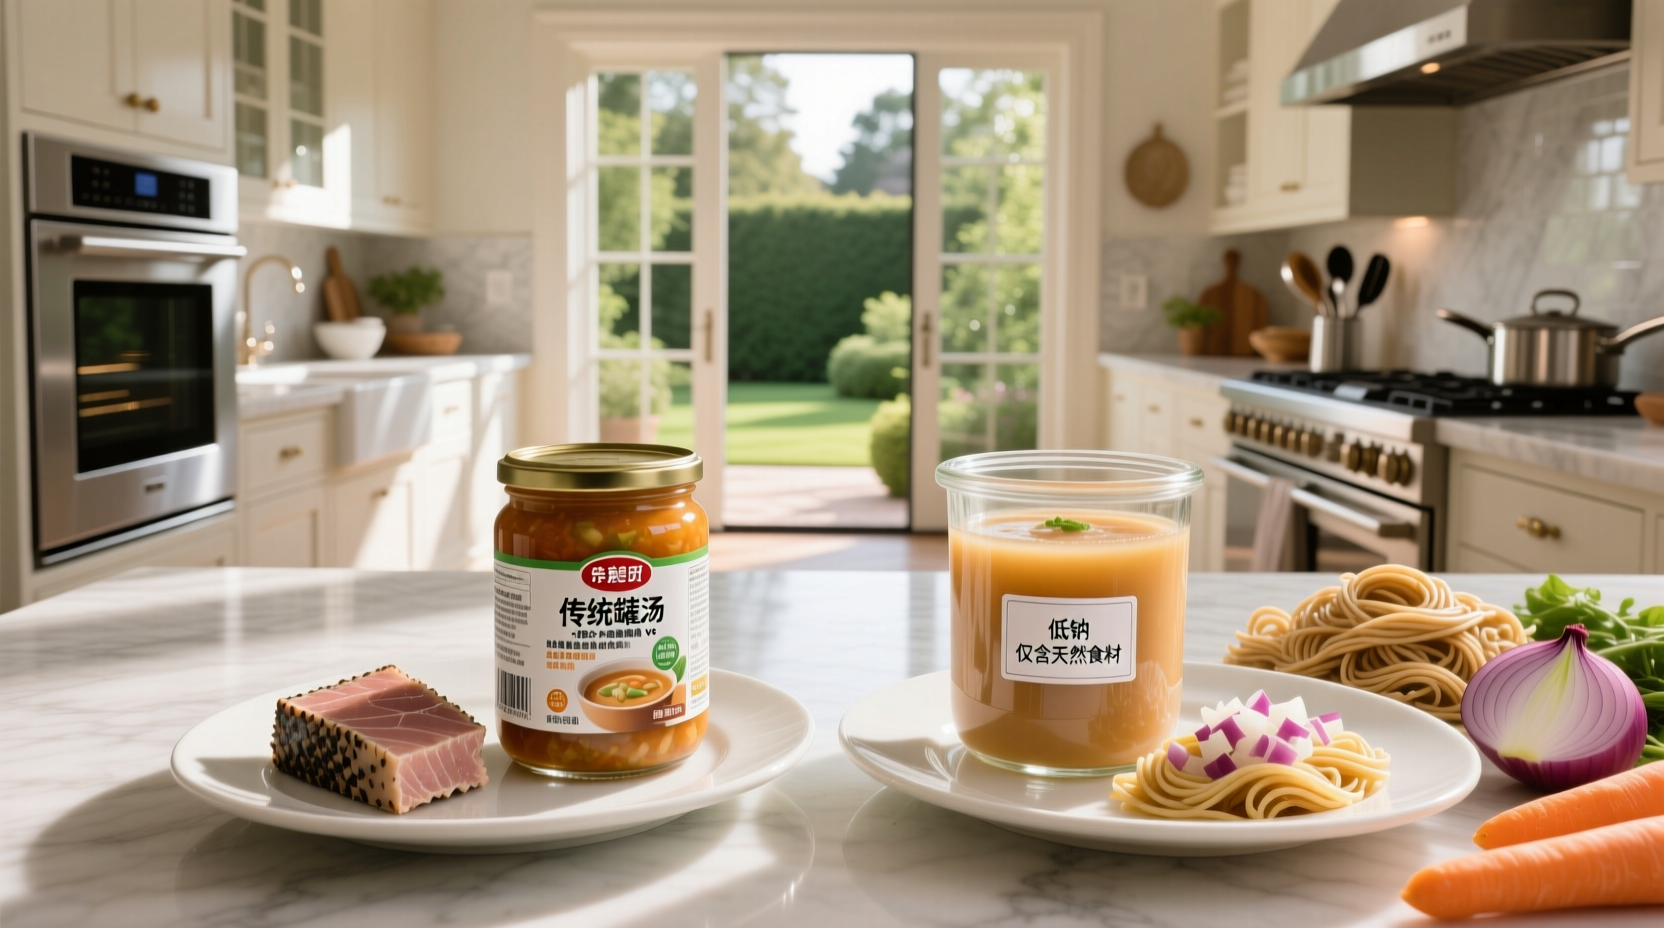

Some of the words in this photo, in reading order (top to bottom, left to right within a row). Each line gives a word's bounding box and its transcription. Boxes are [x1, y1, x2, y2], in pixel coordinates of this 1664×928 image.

[559, 596, 665, 628] 传统罐汤
[1048, 618, 1090, 640] 低钠
[1016, 643, 1122, 665] 仅含天然食材
